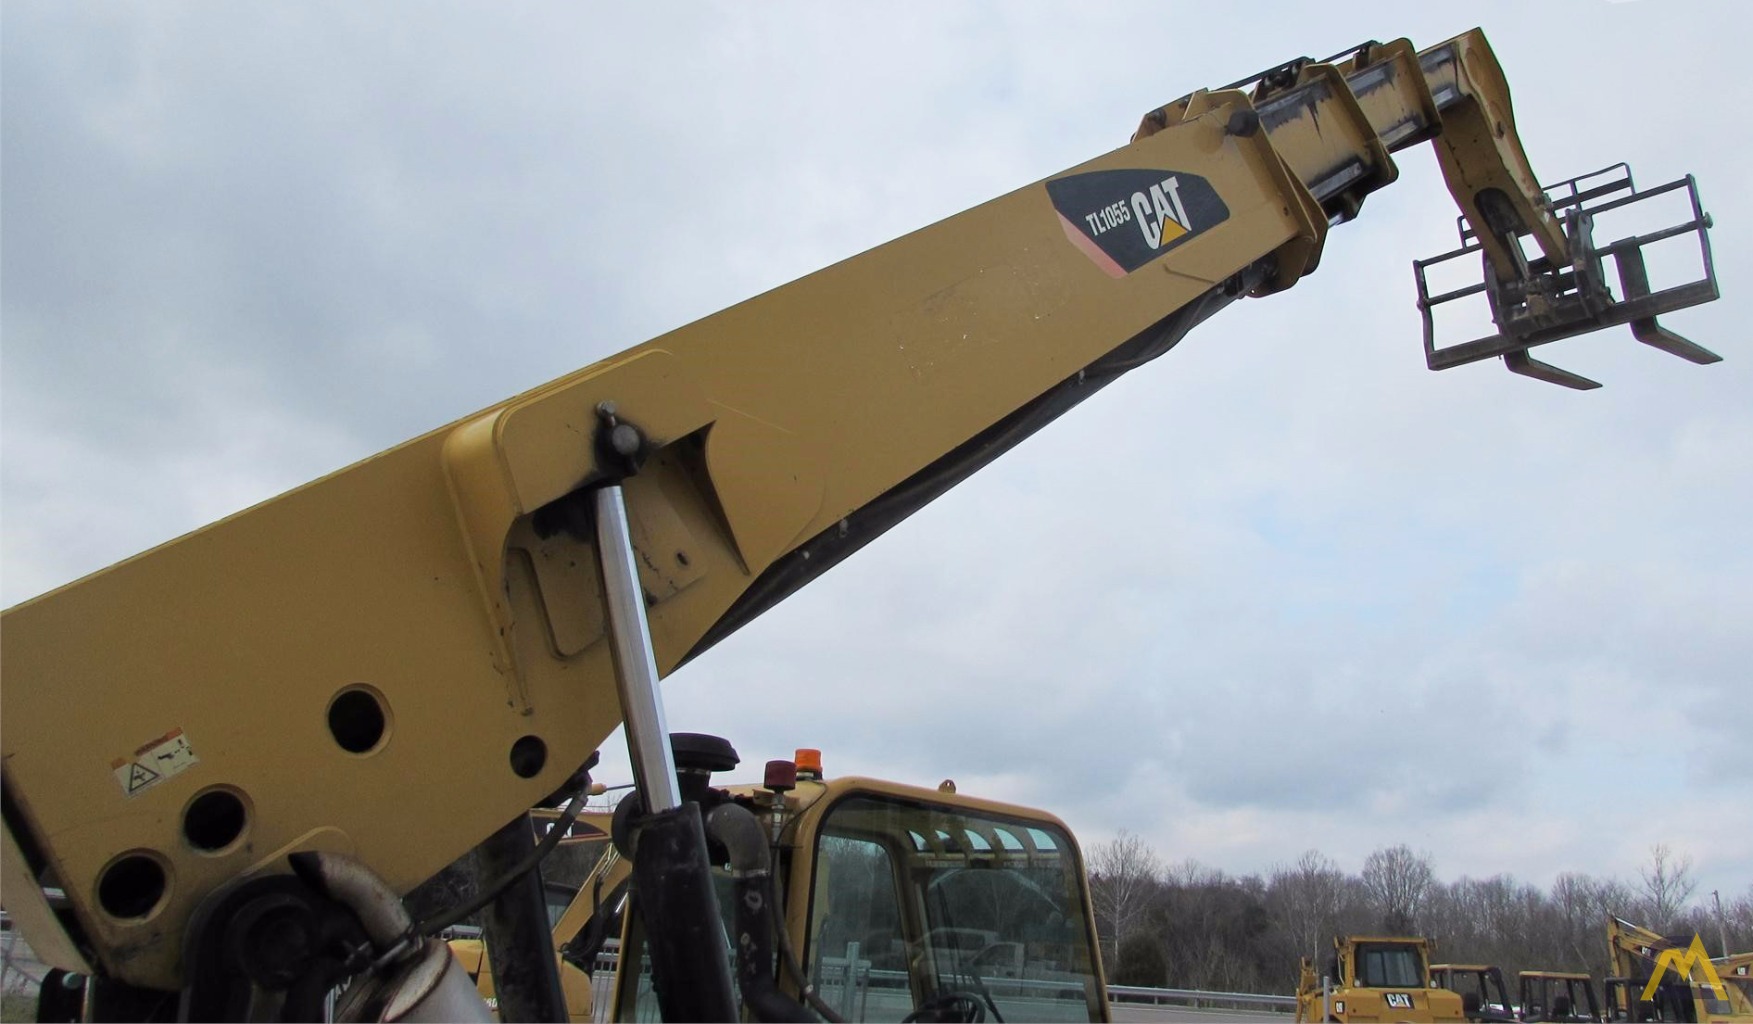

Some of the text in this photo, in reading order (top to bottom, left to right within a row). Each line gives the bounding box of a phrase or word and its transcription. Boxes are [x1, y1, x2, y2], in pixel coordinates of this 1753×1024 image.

[1085, 176, 1192, 250] TL1055 CAT
[1386, 993, 1411, 1008] CAT
